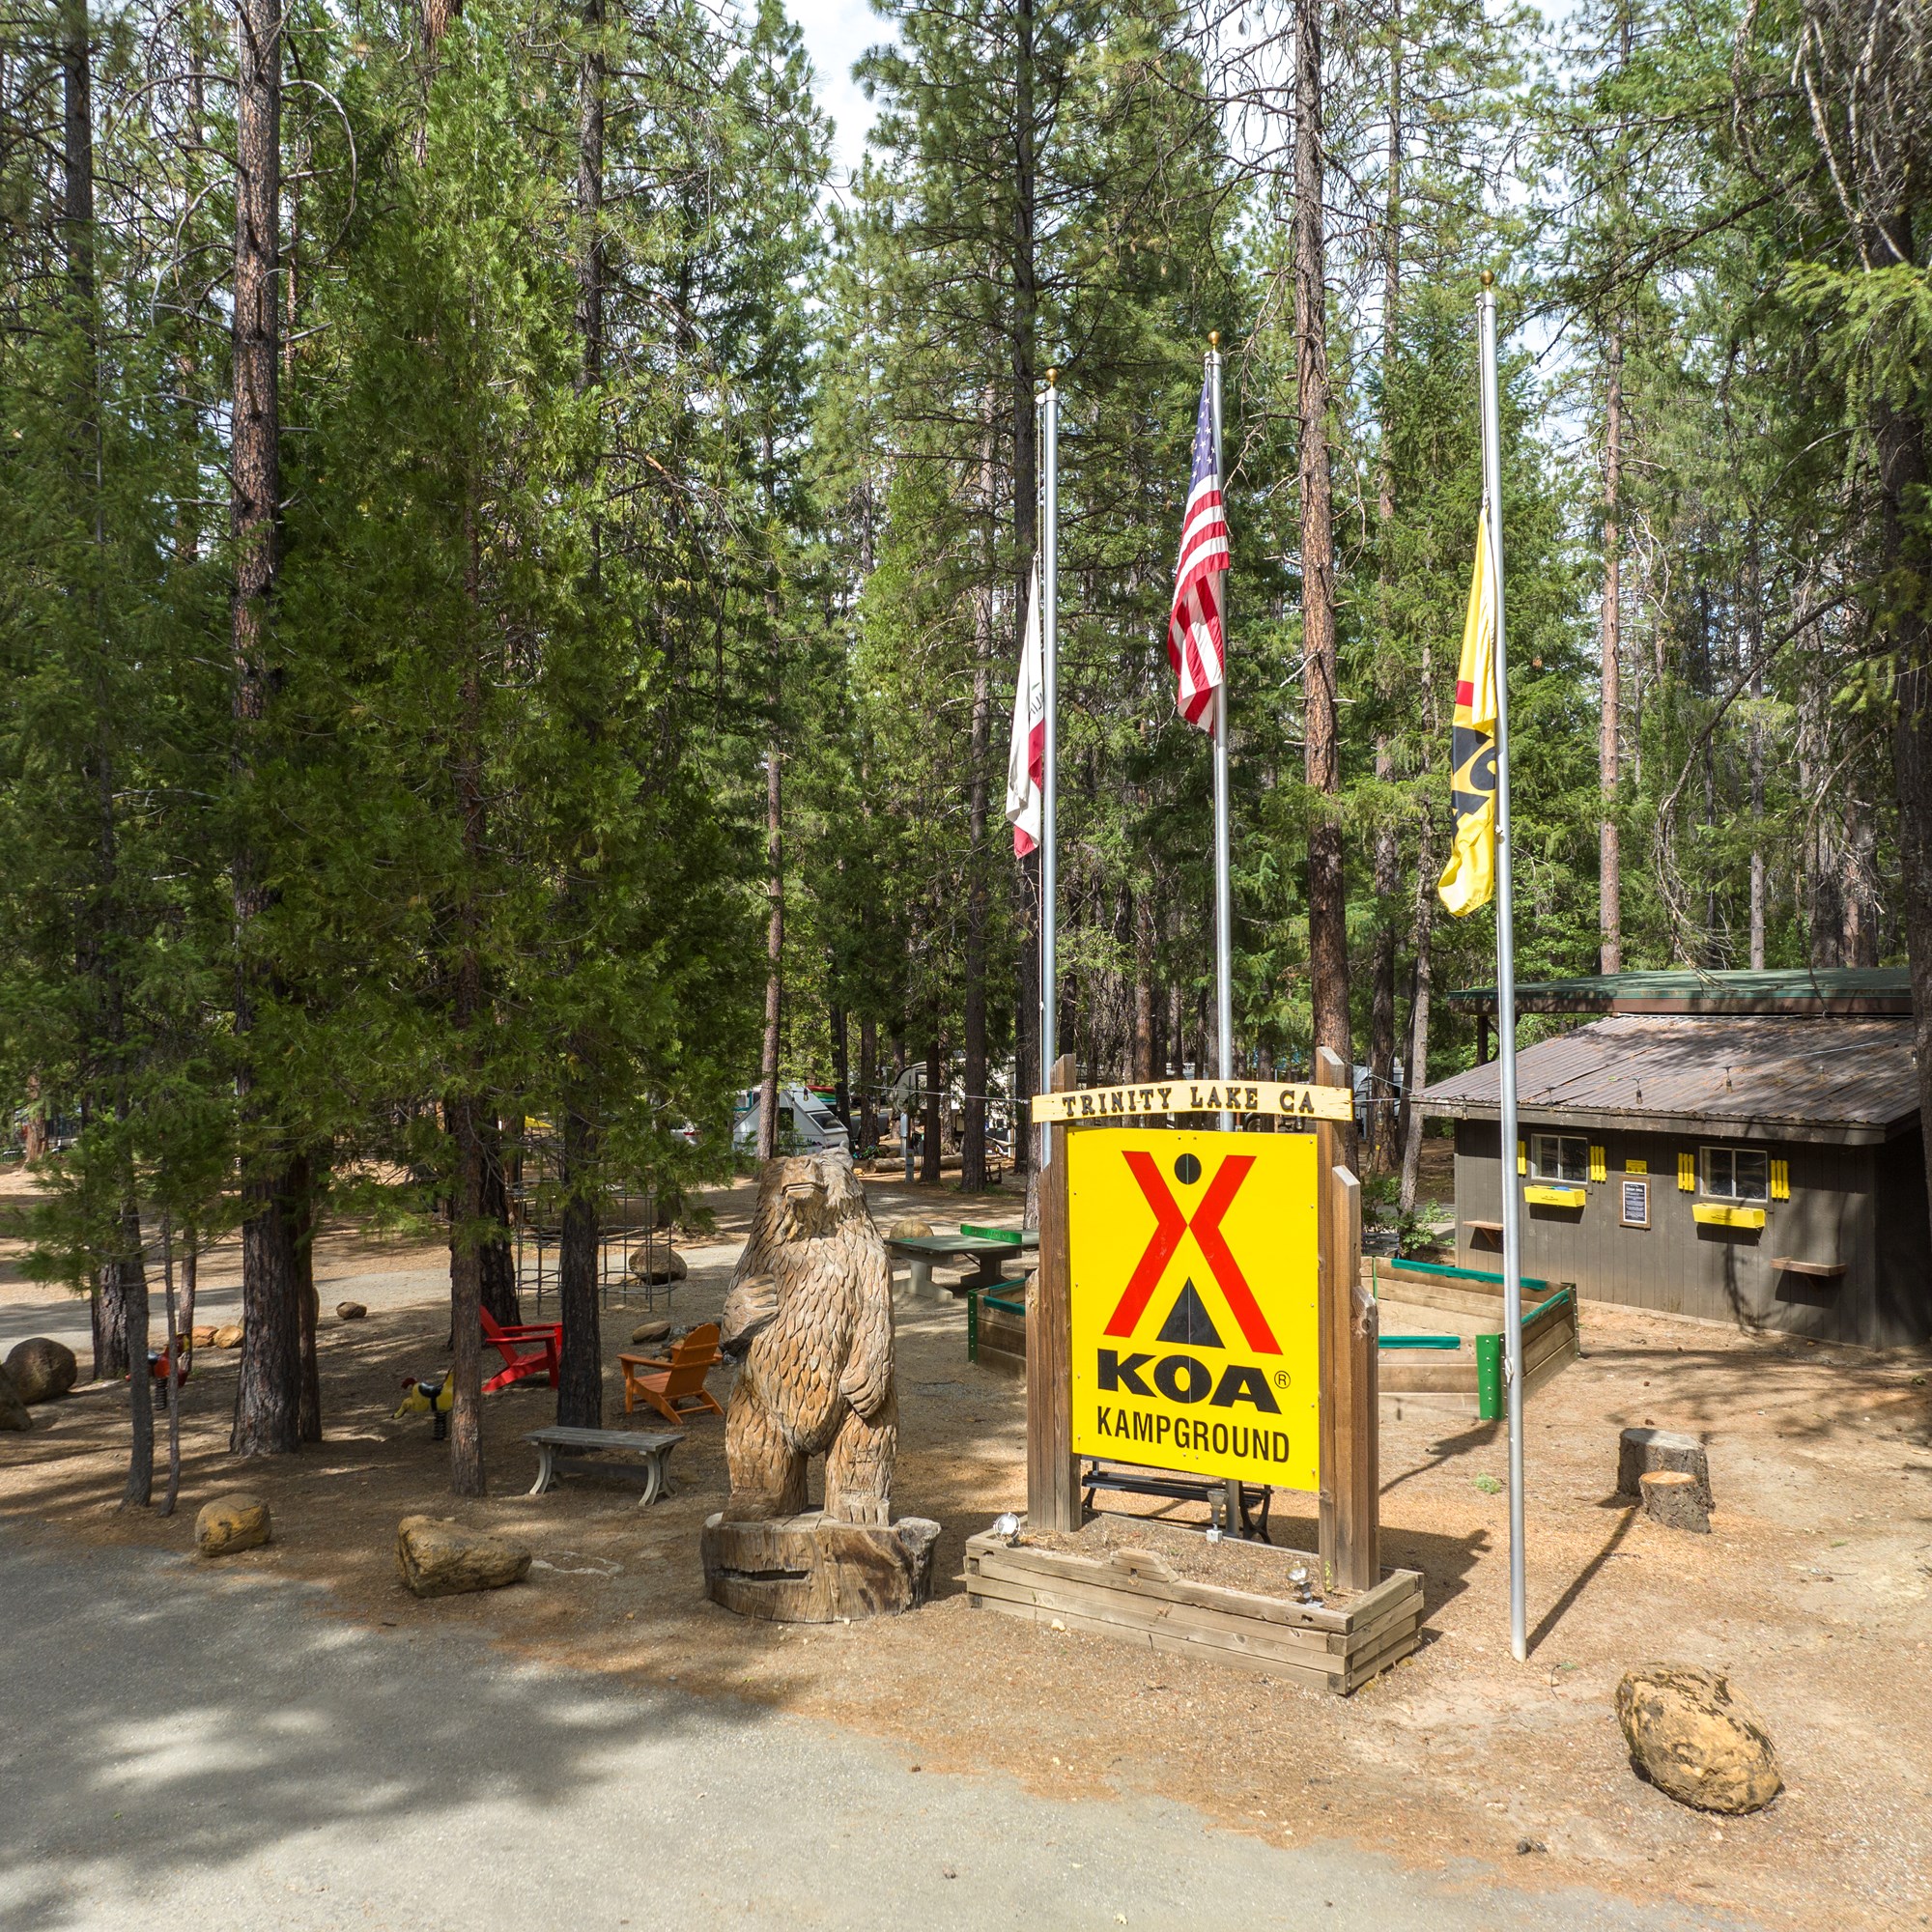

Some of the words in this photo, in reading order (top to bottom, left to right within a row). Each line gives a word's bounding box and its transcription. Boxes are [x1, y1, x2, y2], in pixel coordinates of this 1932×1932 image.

[1062, 1087, 1172, 1117] TRINITY
[1190, 1086, 1258, 1110] LAKE
[1279, 1090, 1315, 1113] CA
[1097, 1406, 1290, 1463] KAMPGROUND
